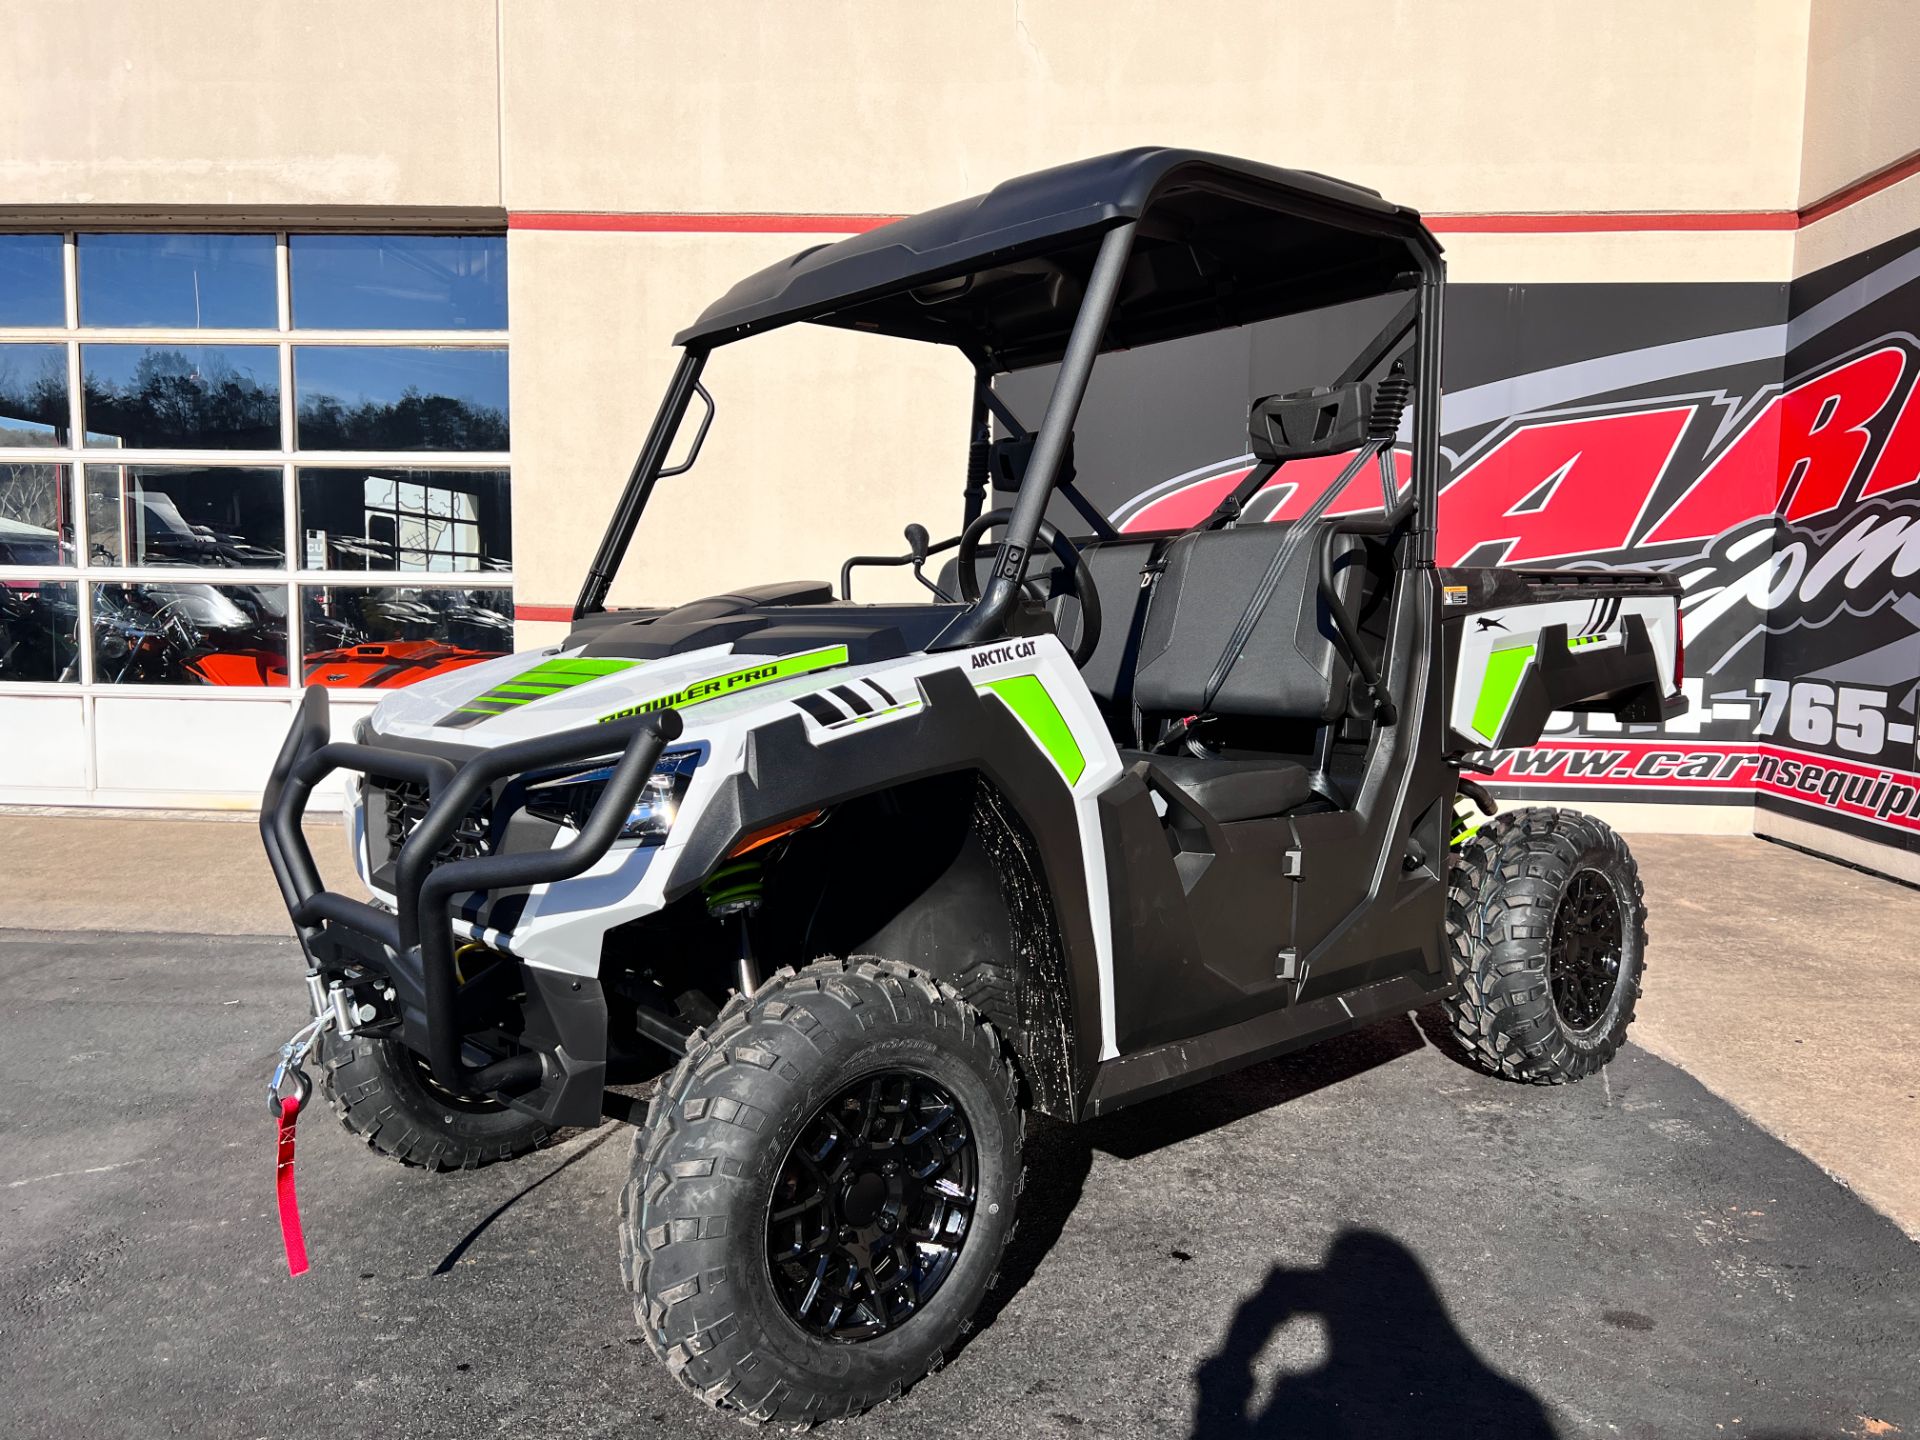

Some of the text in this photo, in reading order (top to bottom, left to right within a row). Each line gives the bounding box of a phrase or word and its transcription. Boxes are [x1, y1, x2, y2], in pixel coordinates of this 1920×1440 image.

[1117, 346, 1920, 570] AR
[728, 665, 778, 688] PRO
[971, 640, 1036, 669] ARCTIC CAT
[1459, 748, 1920, 821] www.carnsequip
